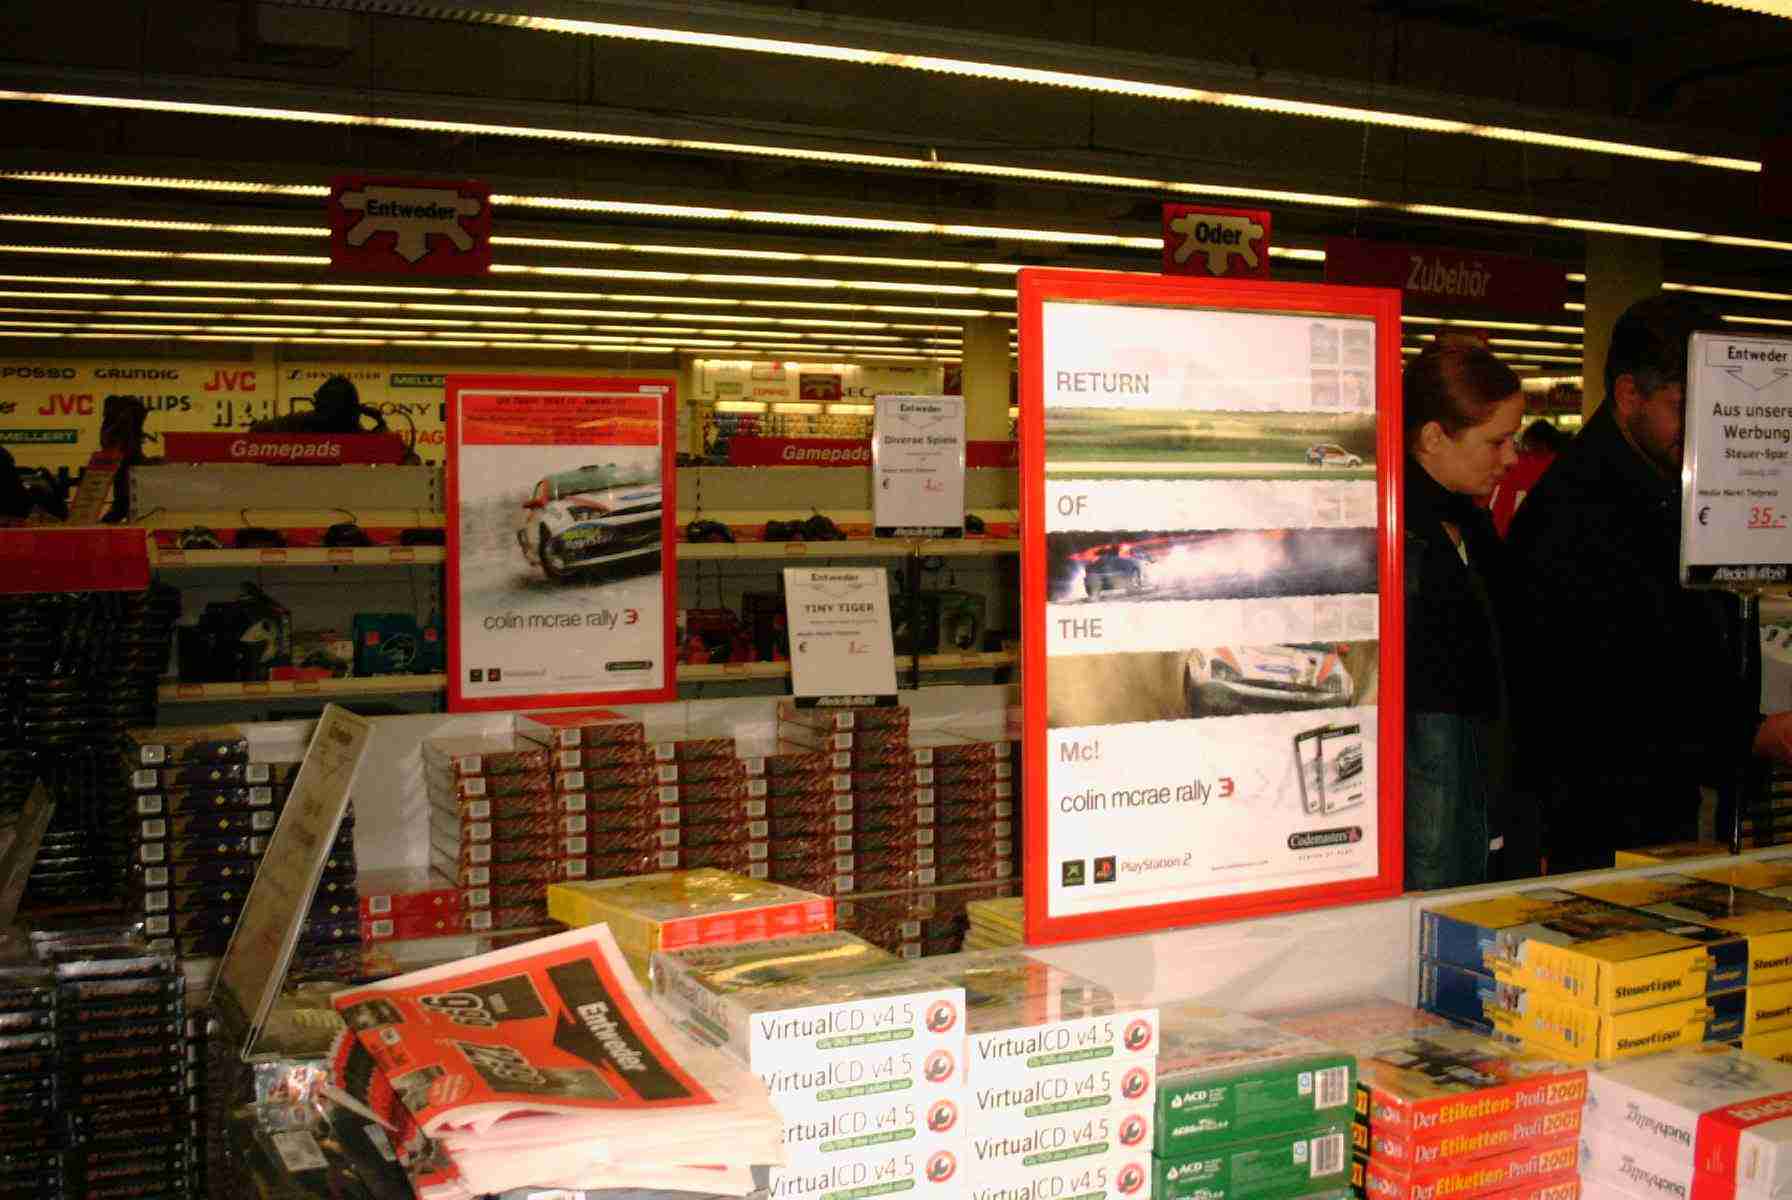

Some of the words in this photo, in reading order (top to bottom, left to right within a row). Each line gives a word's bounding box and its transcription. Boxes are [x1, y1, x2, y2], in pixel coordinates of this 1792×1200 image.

[365, 199, 454, 219] Entweder
[1195, 221, 1241, 245] Oder
[1406, 254, 1491, 298] Zubehör
[1728, 345, 1788, 362] Entweder
[94, 368, 179, 380] GRUNDIG
[203, 370, 257, 392] JVC
[1056, 371, 1150, 394] RETURN
[37, 394, 94, 416] JVC
[900, 403, 941, 413] Entweder
[1713, 402, 1741, 417] Aus
[1723, 425, 1791, 444] Werbung
[229, 439, 342, 460] Gamepads
[781, 444, 872, 462] Gamepads
[1057, 495, 1088, 516] OF
[1699, 506, 1711, 526] €
[810, 573, 859, 583] Entweder
[804, 603, 833, 614] TINY
[839, 602, 875, 613] TIGER
[483, 611, 524, 630] colin
[528, 611, 582, 629] mcrae
[585, 609, 618, 630] rally
[624, 608, 639, 625] 3
[1058, 618, 1102, 639] THE
[1060, 740, 1099, 762] Mc!
[1060, 789, 1106, 813] colin
[1112, 786, 1171, 809] mcrae
[1176, 779, 1212, 806] rally
[1217, 776, 1235, 799] 3
[1290, 831, 1348, 848] Codemasters
[760, 1008, 864, 1041] VirtualCD
[576, 1000, 648, 1073] Entweder
[977, 1028, 1070, 1060] VirtualCD
[976, 1077, 1068, 1111] VirtualCD
[1414, 1111, 1439, 1130] Der
[974, 1126, 1066, 1161] VirtualCD
[1415, 1145, 1438, 1164] Der
[1411, 1183, 1436, 1200] Der
